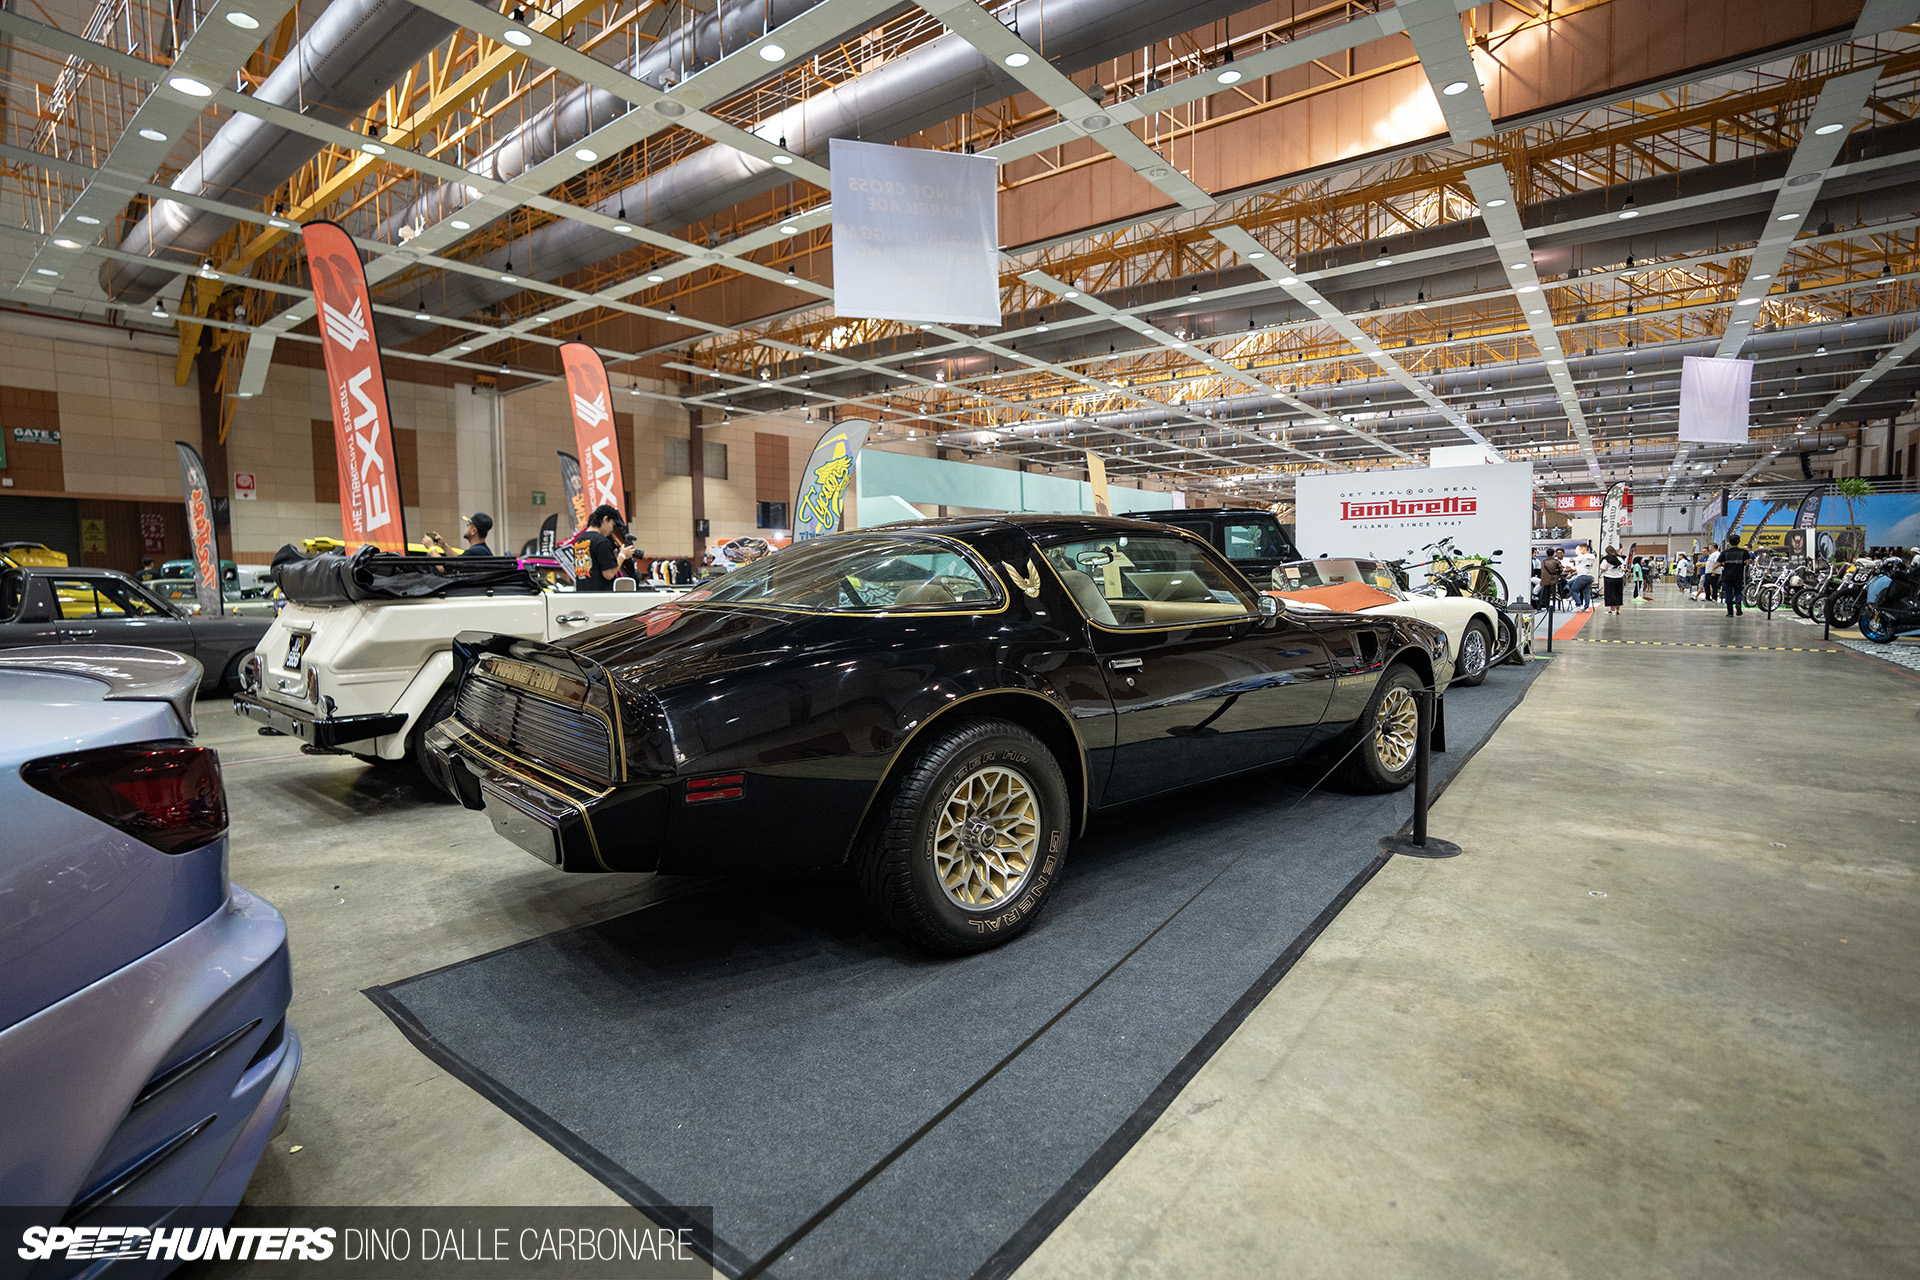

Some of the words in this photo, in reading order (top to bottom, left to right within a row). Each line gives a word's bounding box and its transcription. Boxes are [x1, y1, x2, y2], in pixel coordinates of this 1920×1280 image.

[14, 427, 49, 438] GATE
[53, 431, 61, 439] 3
[1340, 496, 1477, 520] Lambretta
[1854, 573, 1869, 582] 66
[490, 661, 531, 685] TRANS
[530, 667, 560, 692] AM
[1002, 750, 1030, 764] HP
[968, 830, 1062, 934] GENERAL
